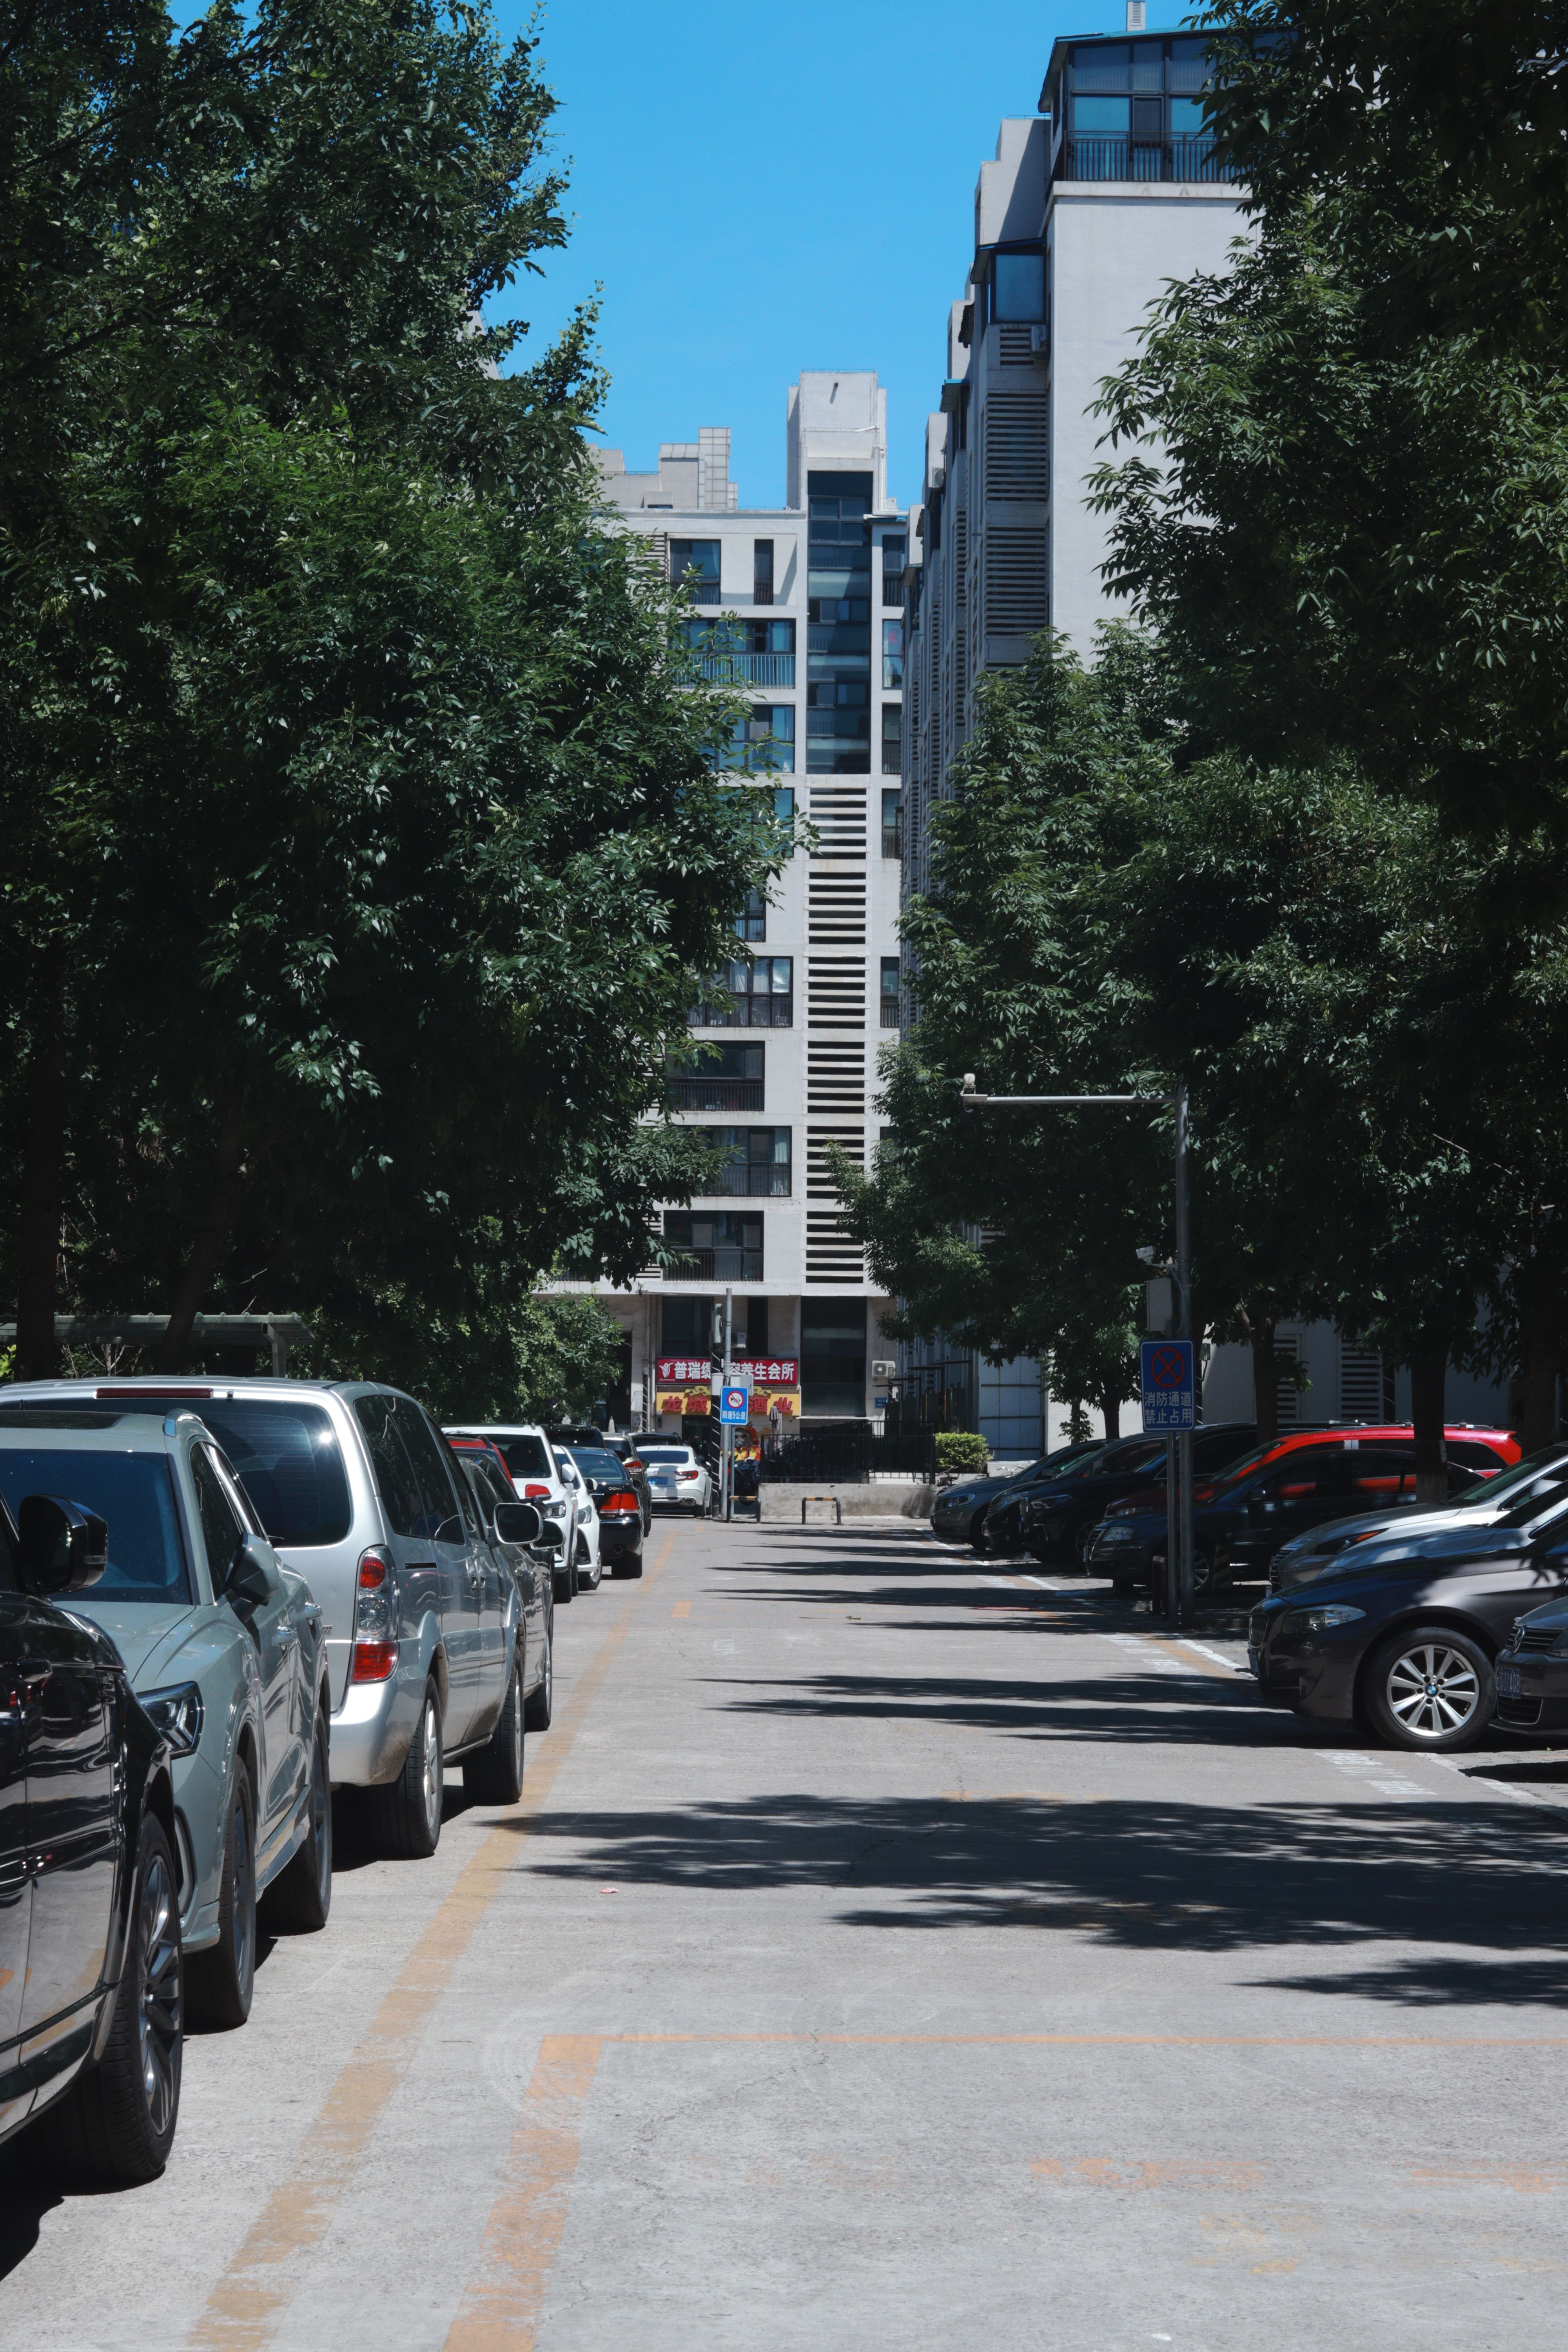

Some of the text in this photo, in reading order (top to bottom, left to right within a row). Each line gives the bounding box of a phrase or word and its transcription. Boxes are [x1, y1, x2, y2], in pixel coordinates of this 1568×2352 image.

[674, 1362, 794, 1381] 普瑞缇容养生会所
[1145, 1391, 1192, 1407] 消防通道
[722, 1410, 746, 1419] 限速5公里
[1145, 1408, 1192, 1424] 禁止占用
